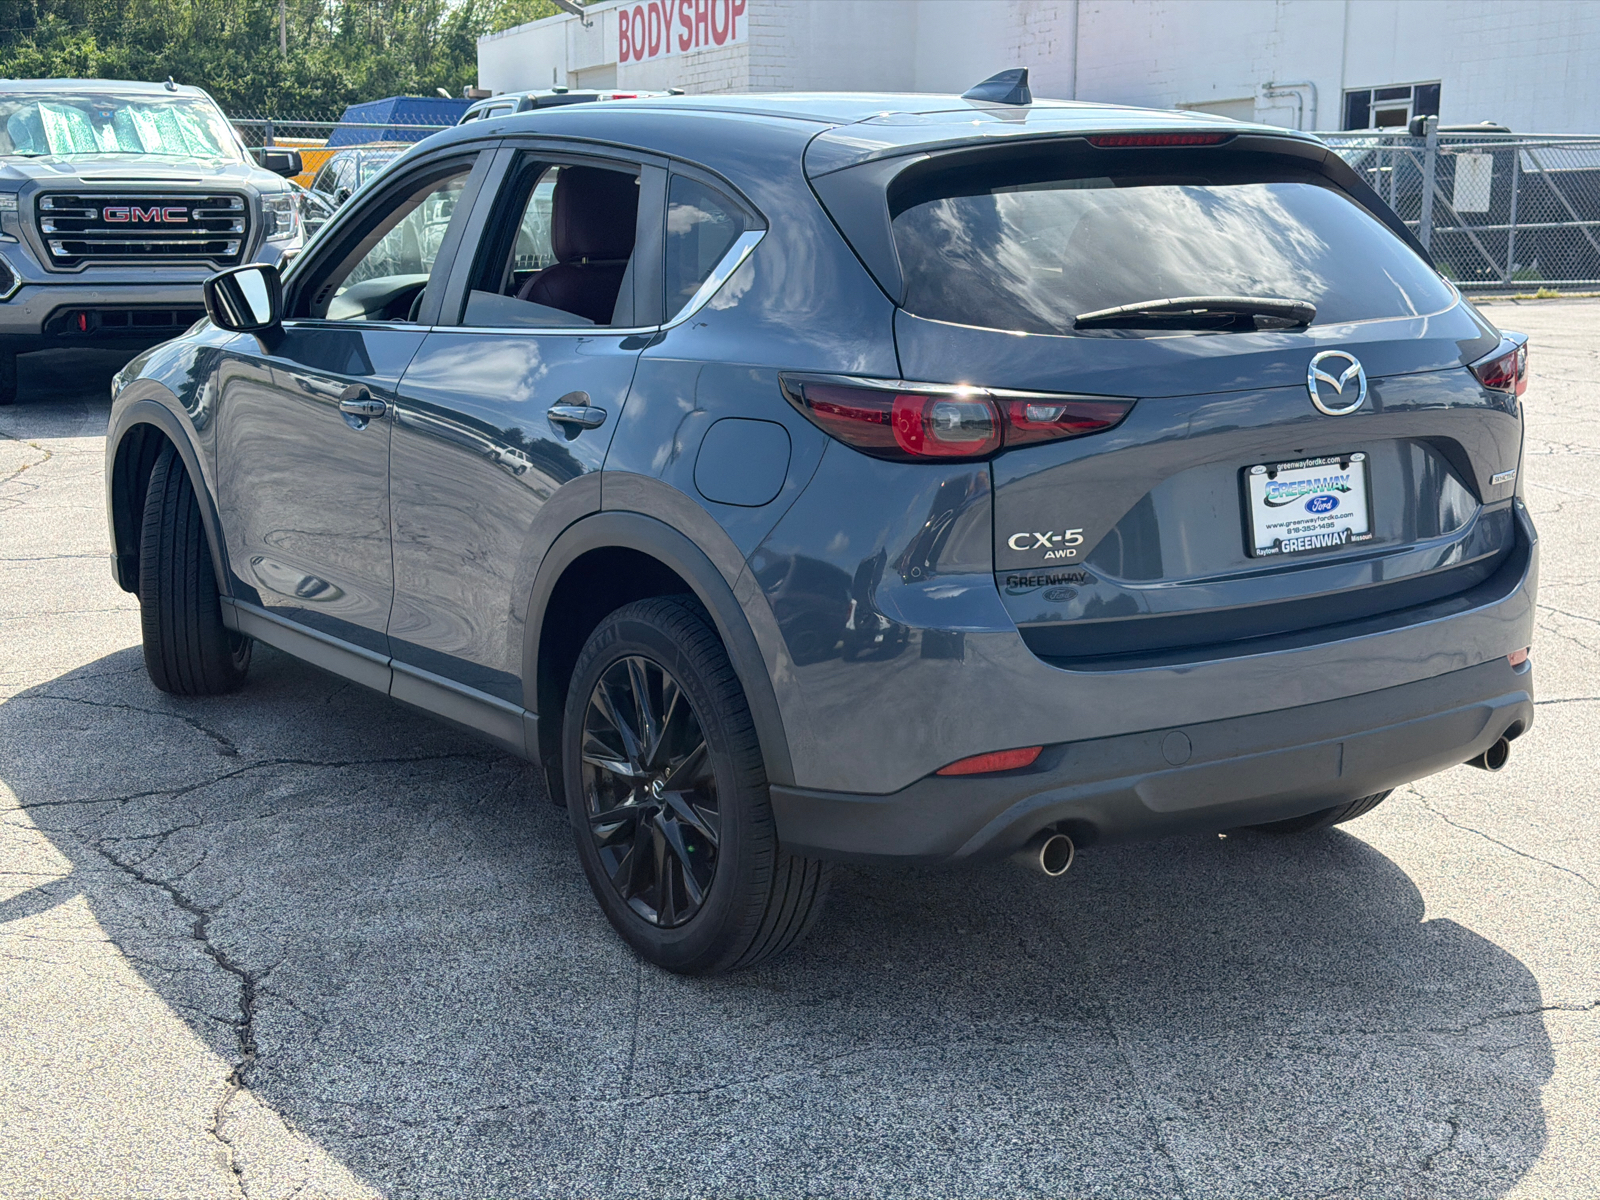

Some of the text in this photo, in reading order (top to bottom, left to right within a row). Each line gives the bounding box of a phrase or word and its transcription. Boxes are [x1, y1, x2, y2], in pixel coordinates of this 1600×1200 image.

[103, 207, 188, 222] GMC
[1276, 456, 1341, 472] greenwayfordkc.com
[1265, 474, 1350, 500] GREENWAY
[1311, 496, 1334, 512] Ford
[1265, 512, 1354, 530] www.greenwayfordkc.com
[1007, 528, 1084, 551] CX-5
[1256, 531, 1373, 557] Raytown GREENWAY Missouri
[1044, 548, 1077, 560] AWD
[1006, 571, 1087, 589] GREENWAY
